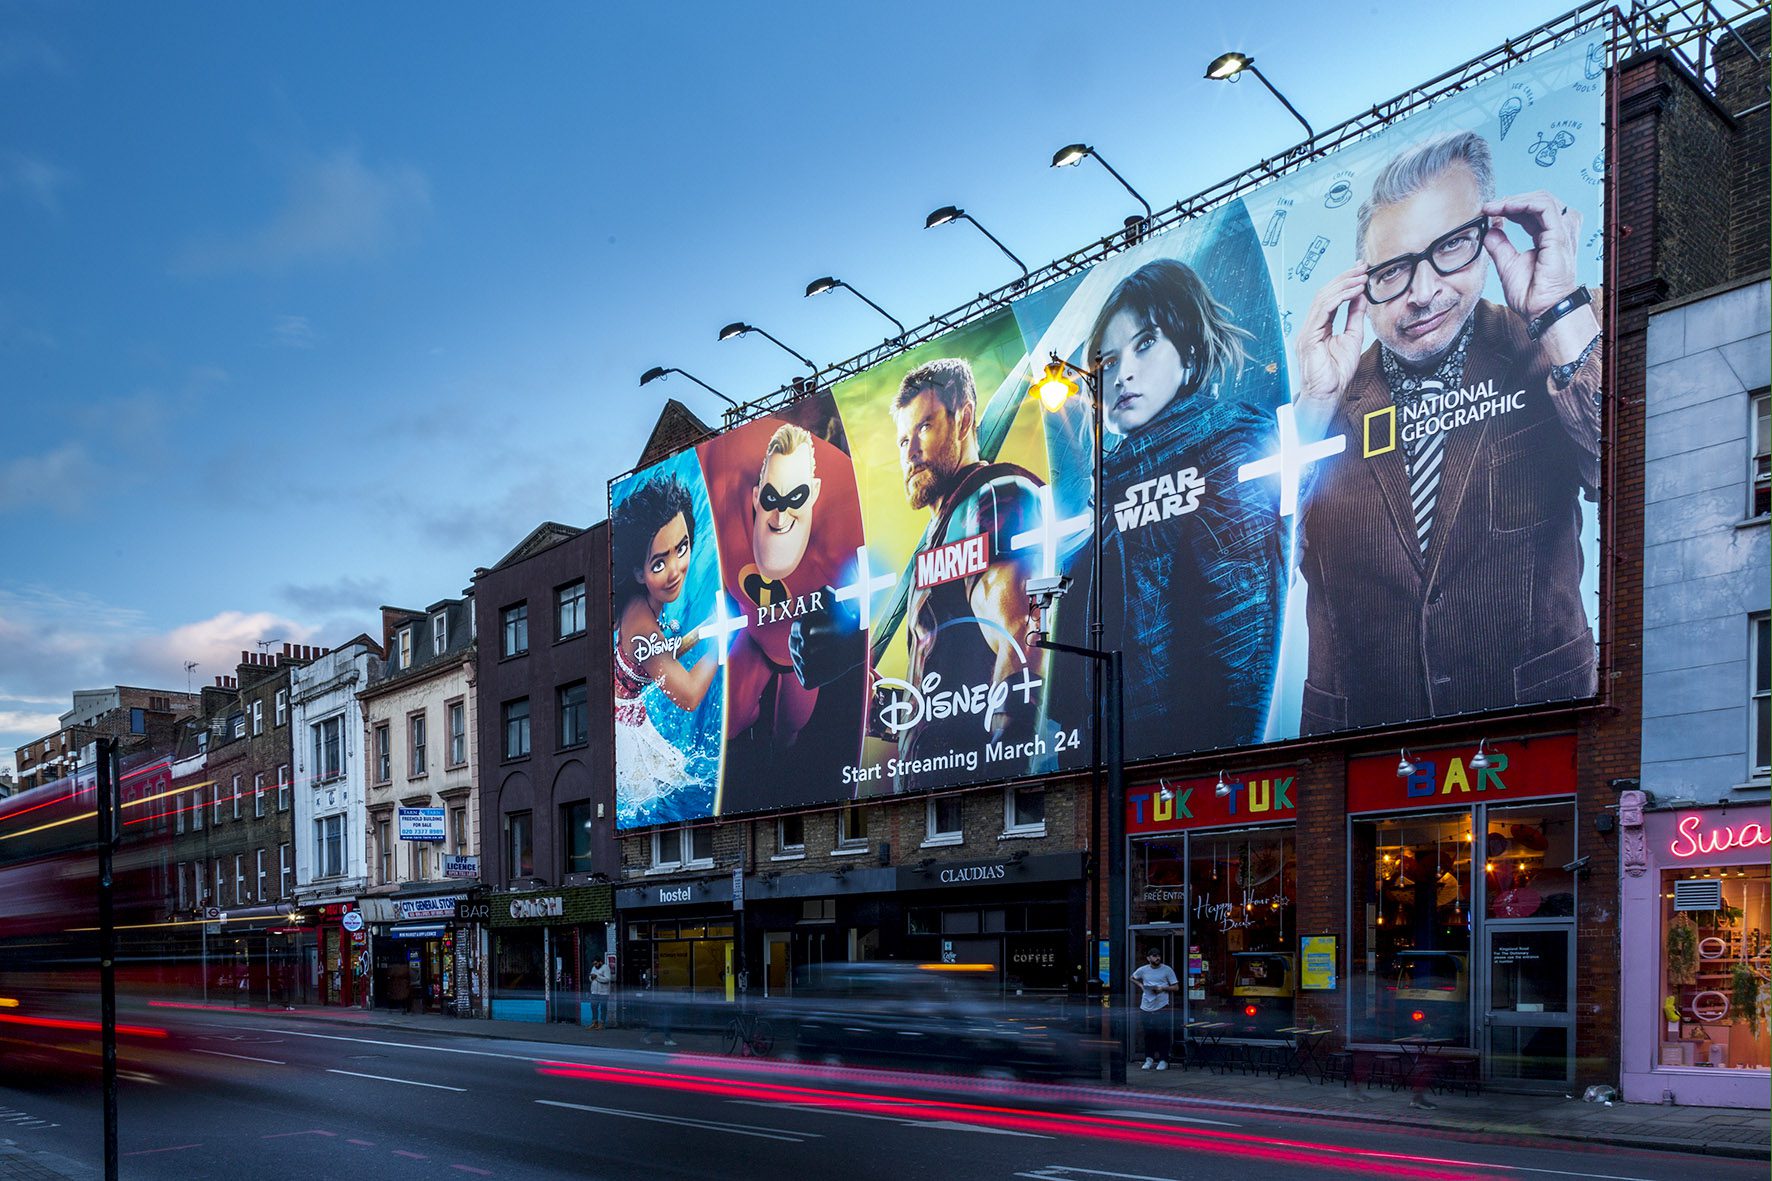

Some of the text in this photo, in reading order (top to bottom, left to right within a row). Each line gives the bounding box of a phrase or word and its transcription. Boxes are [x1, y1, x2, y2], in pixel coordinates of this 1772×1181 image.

[1550, 120, 1583, 130] GAMING
[1401, 390, 1526, 442] GEOGRAPHIC
[1402, 379, 1499, 423] NATIONAL
[1114, 466, 1206, 512] STAR
[1114, 486, 1206, 533] WARS
[918, 536, 987, 588] MARVEL
[756, 591, 824, 627] PIXAR
[842, 729, 1081, 784] Start Streaming March 24
[1407, 754, 1509, 798] BAR
[1130, 777, 1295, 824] TUK TUK
[447, 863, 476, 871] LICENCE
[940, 864, 1005, 883] CLAUDIA'S
[402, 895, 457, 912] CITY GENERAL STOR
[659, 886, 691, 903] hostel
[1143, 891, 1184, 901] FREE ENTR
[1193, 892, 1233, 921] Happy
[460, 904, 489, 918] BAR
[1013, 953, 1055, 963] COFFEE
